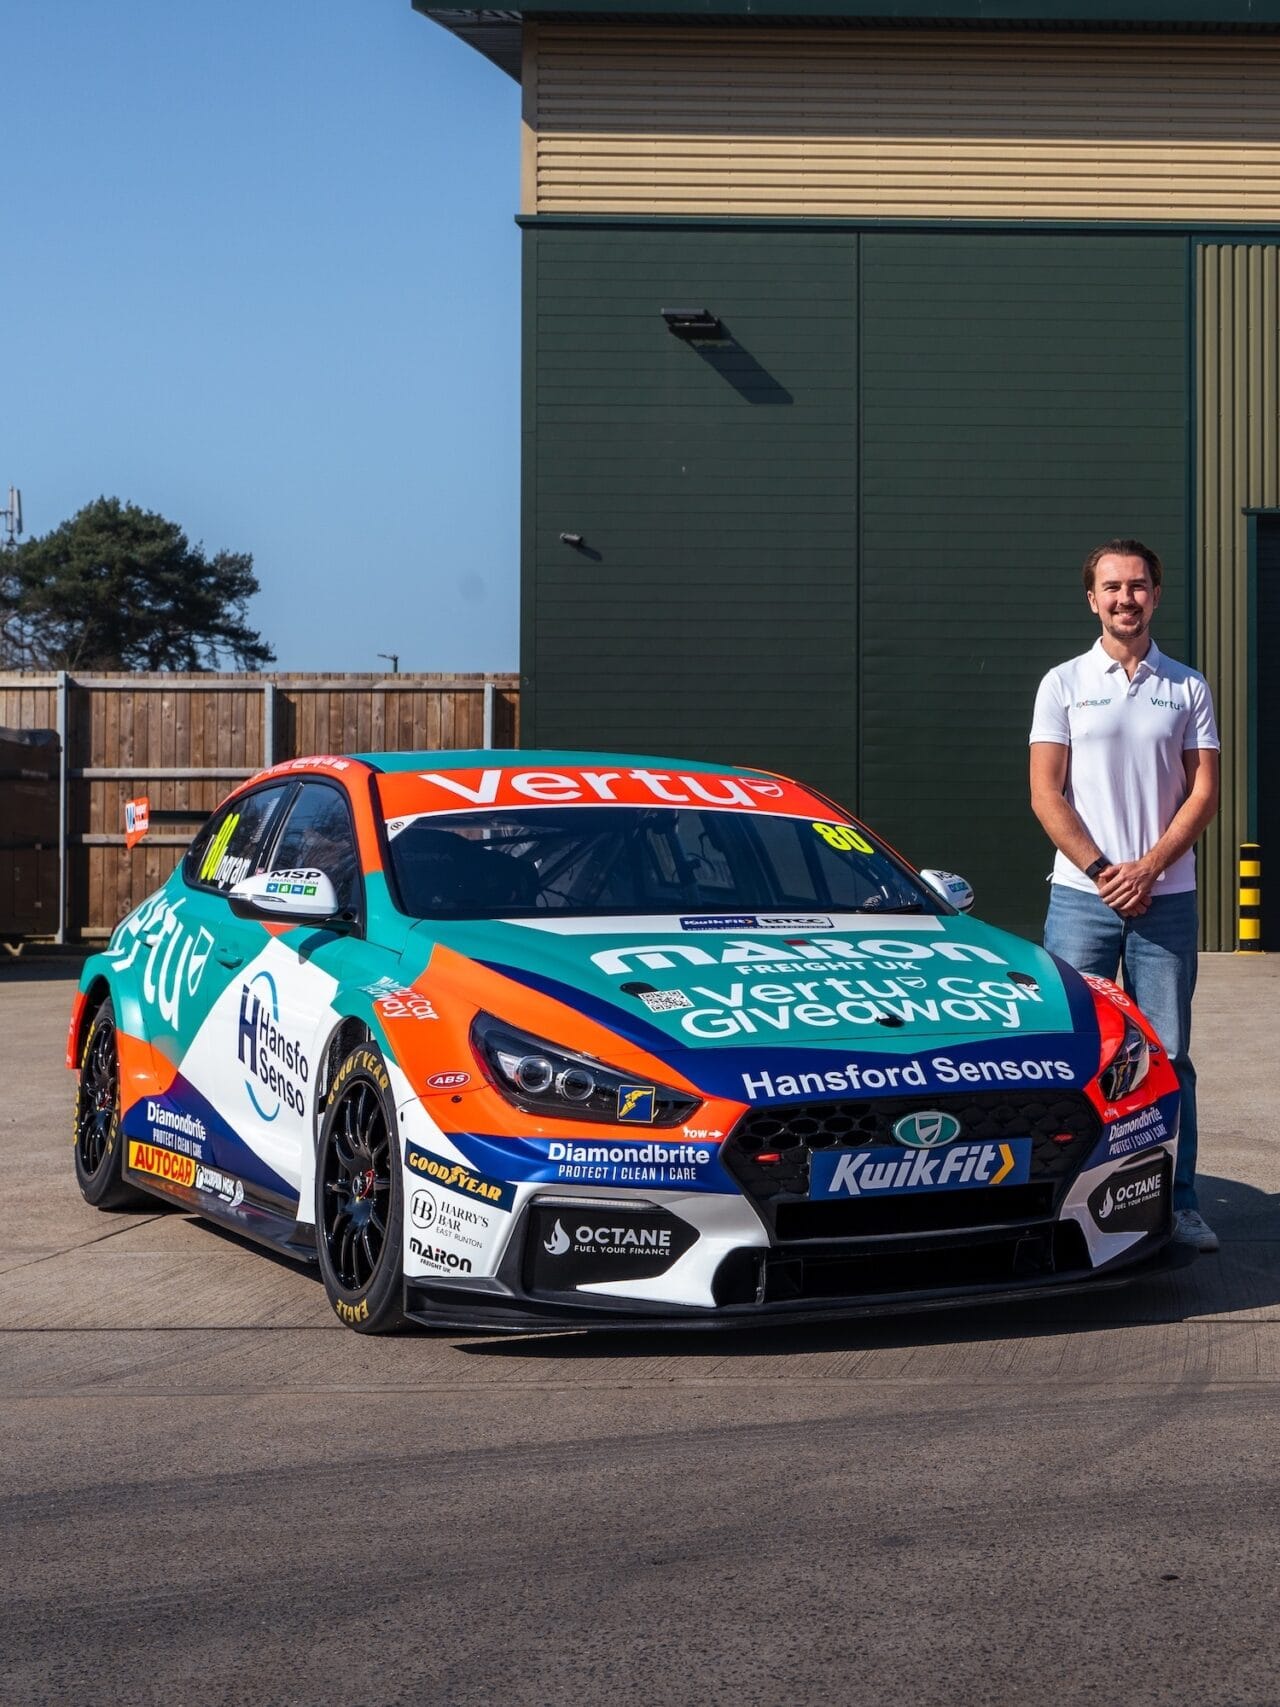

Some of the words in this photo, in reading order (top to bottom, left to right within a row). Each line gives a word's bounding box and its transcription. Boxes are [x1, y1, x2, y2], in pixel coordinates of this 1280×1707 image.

[811, 822, 875, 855] 80
[270, 870, 322, 880] MSP
[734, 961, 867, 975] FREIGHT
[872, 960, 923, 970] UK
[433, 1073, 465, 1086] ABS
[741, 1060, 927, 1099] Hansford
[931, 1057, 1076, 1083] Sensors
[147, 1101, 206, 1142] Diamondbrite
[1108, 1106, 1163, 1141] Diamondbrite
[547, 1142, 711, 1165] Diamondbrite
[1109, 1138, 1133, 1156] PROTECT
[134, 1144, 193, 1185] AUTOCAR
[409, 1151, 503, 1201] GOODYEAR
[558, 1164, 609, 1180] PROTECT
[620, 1166, 657, 1181] CLEAN
[669, 1167, 697, 1180] CARE
[1116, 1173, 1162, 1202] OCTANE
[438, 1213, 462, 1232] BAR
[441, 1201, 490, 1229] HARRY'S
[435, 1226, 453, 1239] EAST
[454, 1233, 484, 1249] RUNTON
[575, 1225, 672, 1247] OCTANE
[574, 1244, 597, 1253] FUEL
[600, 1245, 626, 1254] YOUR
[629, 1247, 671, 1256] FINANCE
[420, 1258, 443, 1271] FREIGHT
[442, 1265, 452, 1274] UK
